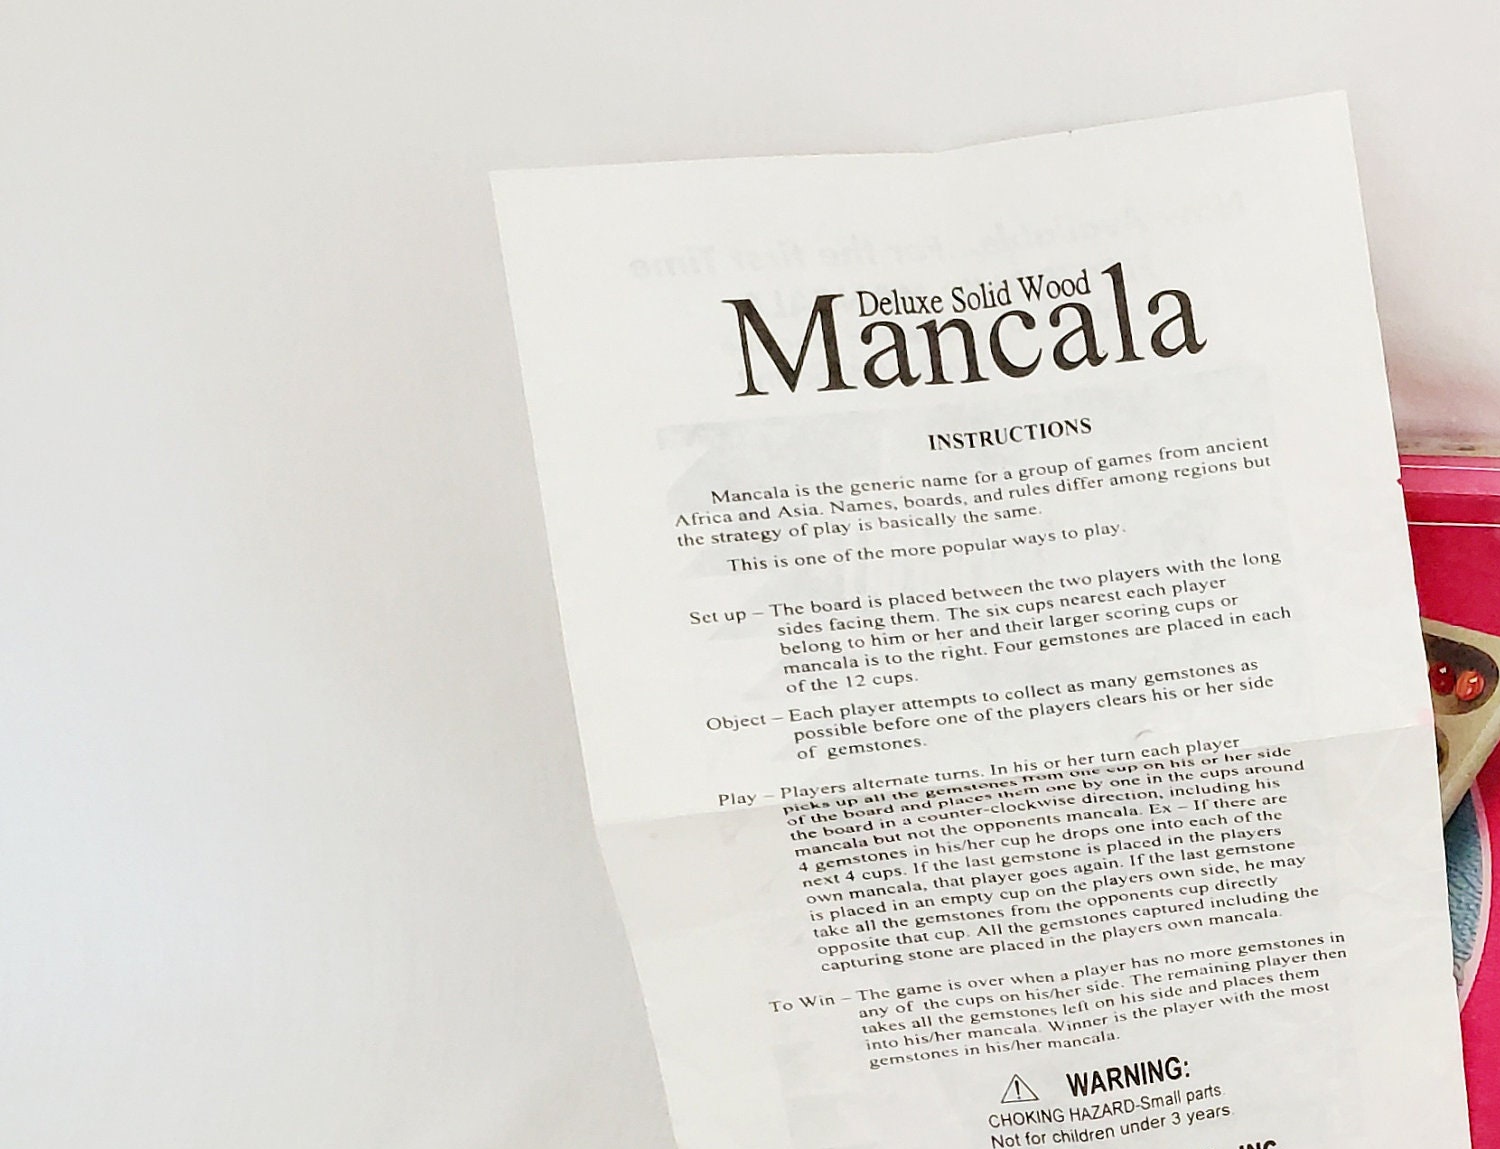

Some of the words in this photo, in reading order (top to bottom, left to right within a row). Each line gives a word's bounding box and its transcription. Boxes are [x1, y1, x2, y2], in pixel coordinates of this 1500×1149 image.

[856, 290, 944, 317] Deluxe
[952, 280, 1013, 313] Solid
[1017, 268, 1092, 301] Wood
[721, 262, 1208, 397] Mancala
[928, 417, 1093, 451] INSTRUCTIONS
[675, 511, 734, 527] Africa
[738, 505, 771, 522] and
[777, 503, 824, 519] Asia.
[829, 500, 898, 515] Names,
[903, 492, 968, 509] boards,
[973, 487, 1004, 504] and
[1008, 483, 1051, 500] rules
[1055, 476, 1104, 493] differ
[1109, 470, 1169, 487] among
[1173, 461, 1238, 480] regions
[1242, 456, 1271, 470] but
[711, 486, 791, 505] Mancala
[795, 483, 811, 498] is
[815, 481, 844, 496] the
[850, 479, 915, 497] generic
[921, 475, 968, 488] name
[974, 470, 999, 485] for
[1003, 470, 1013, 481] a
[1018, 463, 1069, 482] group
[1074, 457, 1091, 472] of
[1096, 452, 1153, 472] games
[1158, 446, 1200, 461] from
[1205, 437, 1269, 455] ancient
[677, 533, 705, 547] the
[710, 528, 782, 545] strategy
[788, 522, 809, 537] of
[812, 521, 851, 539] play
[858, 518, 873, 532] is
[877, 512, 957, 530] basically
[962, 510, 989, 524] the
[726, 556, 768, 572] This
[773, 554, 789, 568] is
[794, 554, 827, 567] one
[832, 548, 853, 563] of
[857, 546, 885, 561] the
[890, 545, 937, 558] more
[941, 537, 1007, 558] popular
[1011, 532, 1057, 547] ways
[1061, 529, 1079, 540] to
[689, 611, 718, 625] Set
[723, 610, 747, 625] up
[768, 602, 805, 618] The
[810, 595, 863, 614] board
[867, 595, 883, 609] is
[888, 588, 947, 610] placed
[950, 584, 1023, 601] between
[1028, 578, 1055, 593] the
[1059, 575, 1092, 589] two
[1097, 567, 1161, 588] players
[1165, 558, 1205, 575] with
[1209, 555, 1237, 570] the
[1242, 552, 1282, 566] long
[706, 714, 767, 732] Object
[787, 705, 834, 723] Each
[838, 702, 896, 721] player
[901, 694, 977, 711] attempts
[982, 692, 1000, 702] to
[1004, 683, 1062, 701] collect
[1066, 682, 1085, 693] as
[1089, 675, 1137, 690] many
[1143, 663, 1236, 687] gemstones
[1240, 661, 1259, 672] as
[786, 678, 807, 694] of
[810, 677, 839, 692] the
[845, 674, 866, 688] 12
[872, 673, 919, 688] cups.
[718, 792, 757, 807] Play
[780, 783, 847, 800] Players
[852, 774, 930, 791] alternate
[934, 769, 985, 782] turns.
[989, 763, 1008, 776] In
[1012, 761, 1038, 774] his
[1043, 759, 1062, 770] or
[1066, 754, 1095, 767] her
[1100, 750, 1136, 763] turn
[1140, 742, 1181, 758] each
[1185, 738, 1240, 758] player
[768, 1000, 794, 1013] To
[798, 995, 836, 1008] Win
[855, 988, 891, 1002] The
[896, 983, 943, 1000] game
[947, 979, 962, 991] is
[967, 977, 1005, 989] over
[1009, 972, 1055, 985] when
[1060, 972, 1070, 982] a
[1074, 962, 1127, 982] player
[1130, 957, 1160, 969] has
[1163, 953, 1185, 965] no
[1189, 947, 1233, 961] more
[1237, 936, 1325, 958] gemstones
[1329, 930, 1345, 943] in
[869, 1048, 959, 1070] gemstones
[964, 1046, 980, 1056] in
[985, 1039, 1043, 1054] his/her
[1047, 1030, 1120, 1049] mancala.
[1065, 1055, 1191, 1098] WARNING:
[988, 1107, 1065, 1129] CHOKING
[1068, 1089, 1182, 1123] HAZARD-Small
[990, 1132, 1022, 1149] Not
[1024, 1130, 1047, 1146] for
[1051, 1126, 1116, 1144] children
[1119, 1115, 1167, 1136] under
[1170, 1111, 1182, 1126] 3
